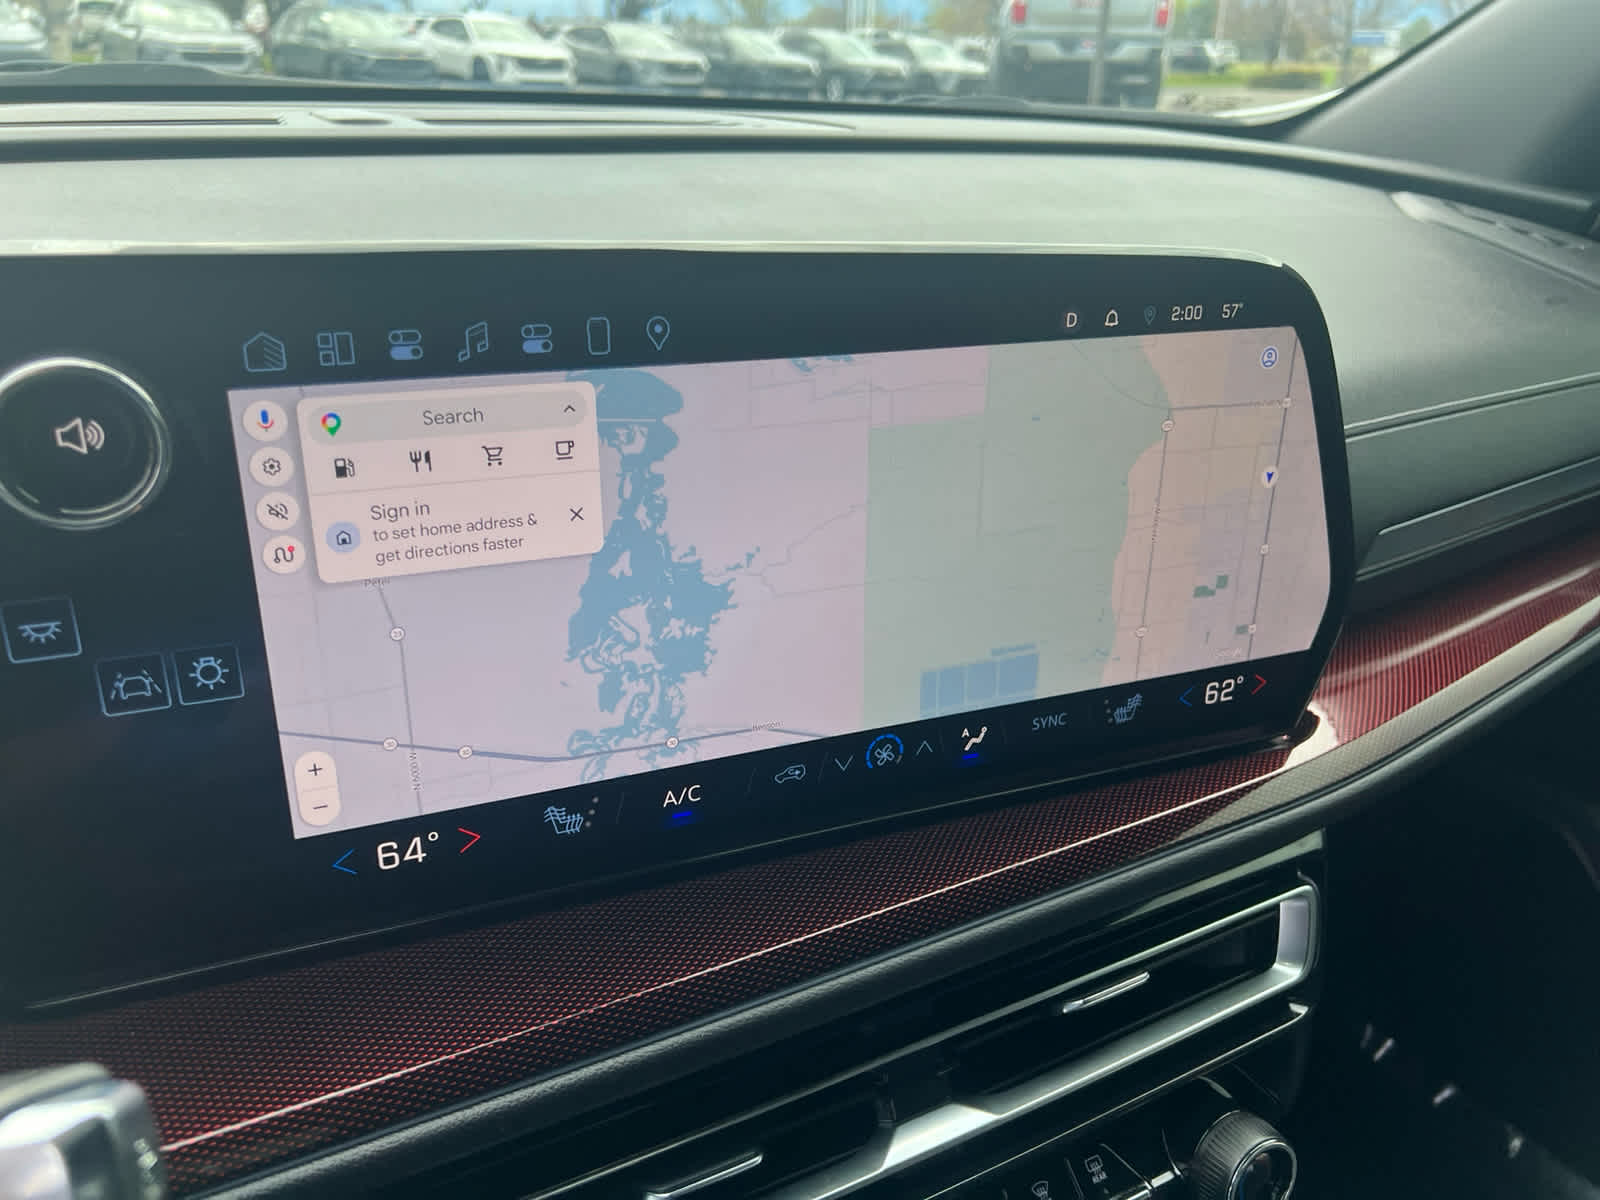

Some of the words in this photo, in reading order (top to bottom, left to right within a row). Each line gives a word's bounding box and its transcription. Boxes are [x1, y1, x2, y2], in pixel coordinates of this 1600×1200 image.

[1065, 312, 1078, 328] D
[1171, 305, 1203, 321] 2:00
[422, 407, 485, 427] Search
[370, 503, 410, 523] Sign
[414, 500, 431, 517] in
[373, 528, 389, 542] to
[392, 526, 416, 541] set
[420, 520, 462, 537] home
[466, 515, 524, 533] address
[526, 513, 538, 527] &
[375, 550, 401, 567] get
[405, 541, 480, 562] directions
[483, 536, 524, 553] faster
[1032, 711, 1069, 731] SYNC
[662, 784, 701, 808] A/C
